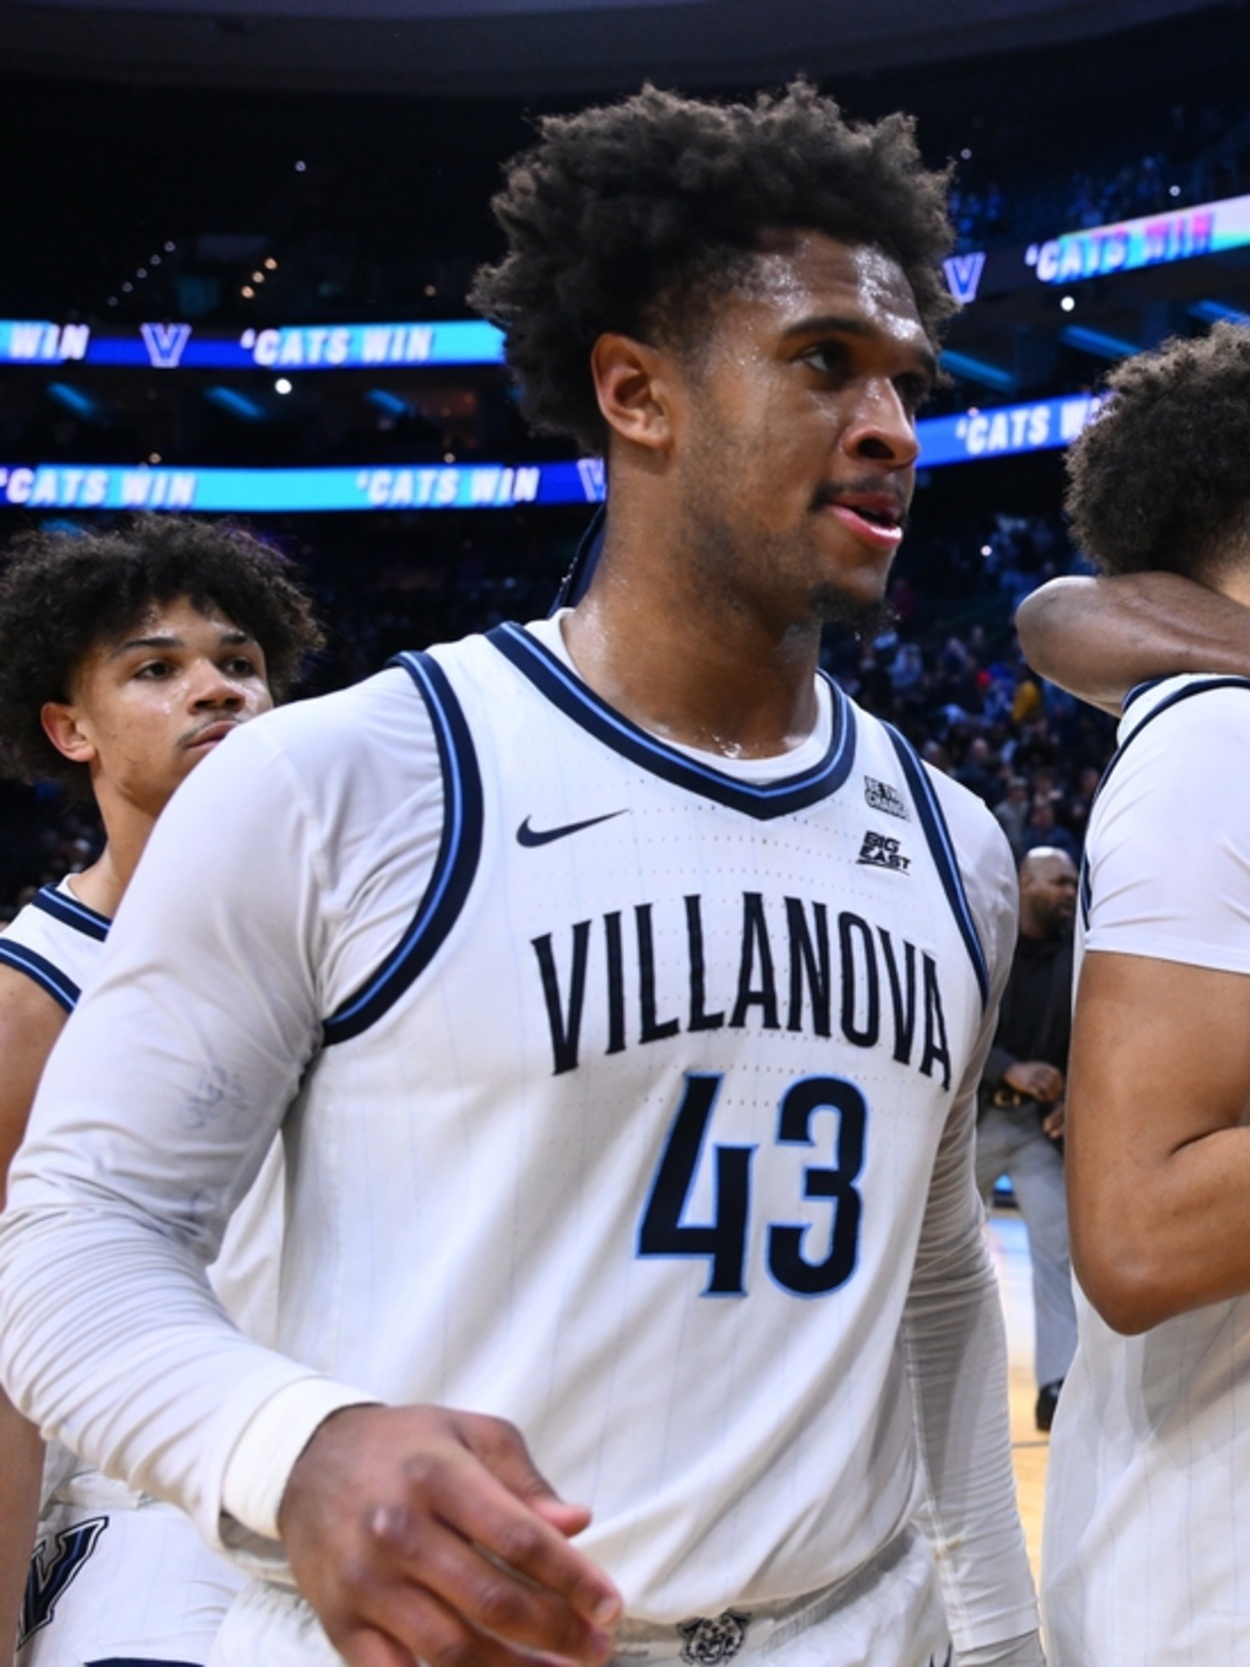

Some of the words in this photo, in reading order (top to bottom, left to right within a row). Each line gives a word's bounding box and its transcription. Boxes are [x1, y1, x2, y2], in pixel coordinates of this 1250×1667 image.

[1025, 228, 1130, 283] 'CATS
[1144, 212, 1215, 264] WIN
[9, 324, 91, 361] WIN
[240, 328, 349, 367] 'CATS
[360, 326, 434, 363] WIN
[955, 404, 1050, 456] 'CATS
[121, 470, 197, 505] WIN
[356, 469, 460, 504] 'CATS
[470, 467, 540, 503] WIN
[859, 845, 911, 869] EAST
[864, 829, 901, 854] BIG
[530, 891, 951, 1092] VILLANOVA
[634, 1071, 870, 1299] 43
